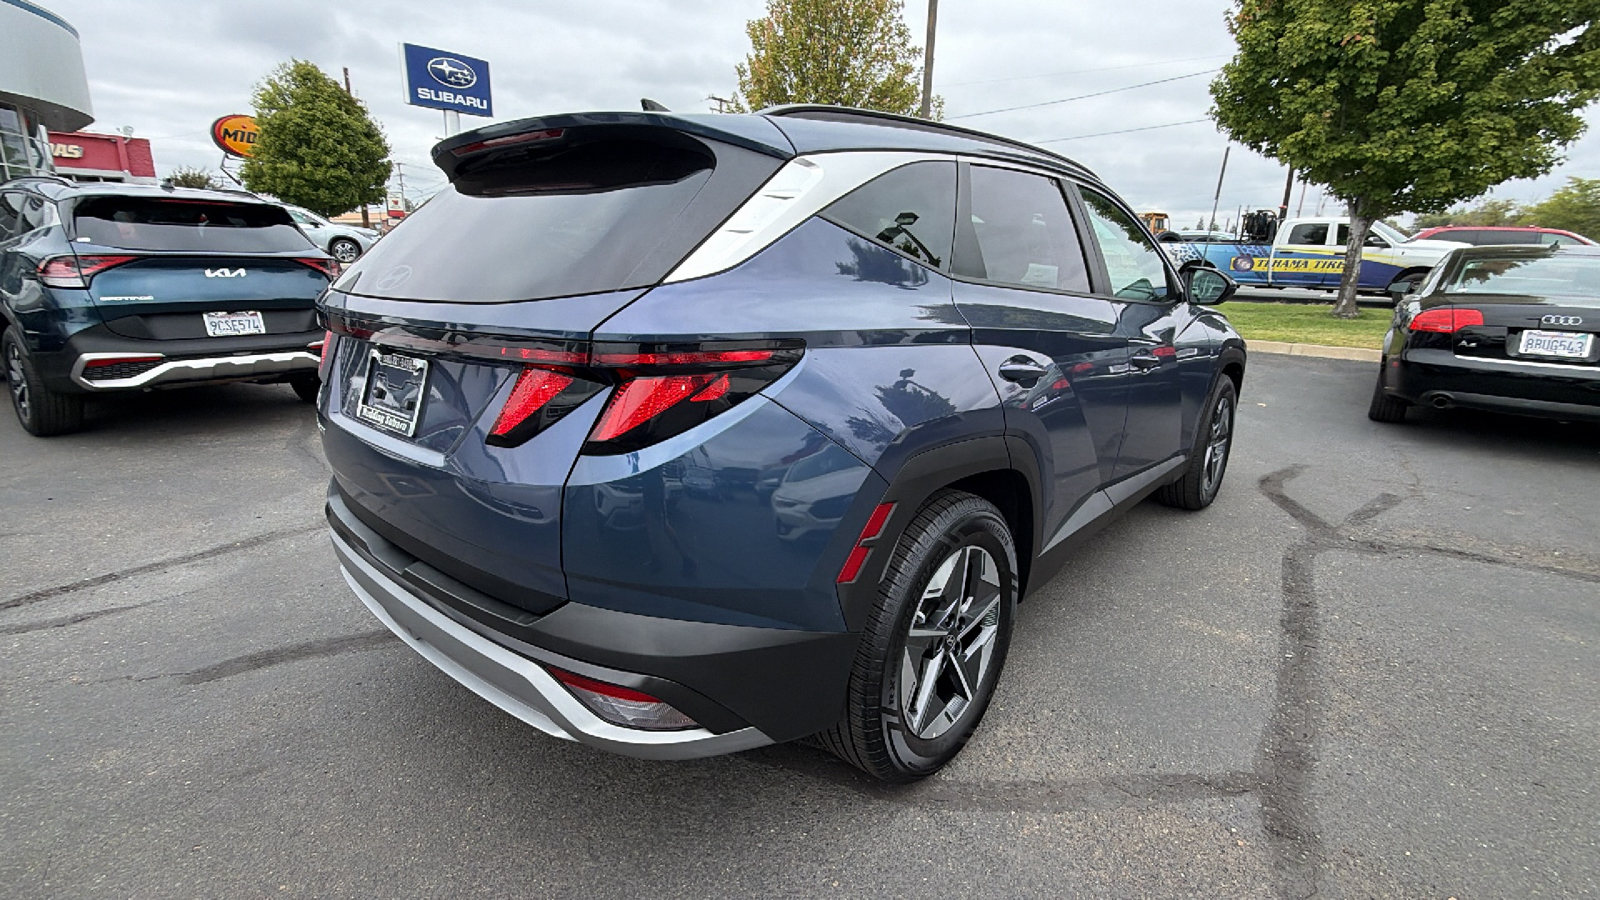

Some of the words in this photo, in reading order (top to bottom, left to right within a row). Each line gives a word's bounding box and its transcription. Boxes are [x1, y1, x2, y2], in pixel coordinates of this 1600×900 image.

[417, 87, 488, 110] SUBARU
[50, 142, 83, 158] AS
[204, 267, 247, 278] KIA
